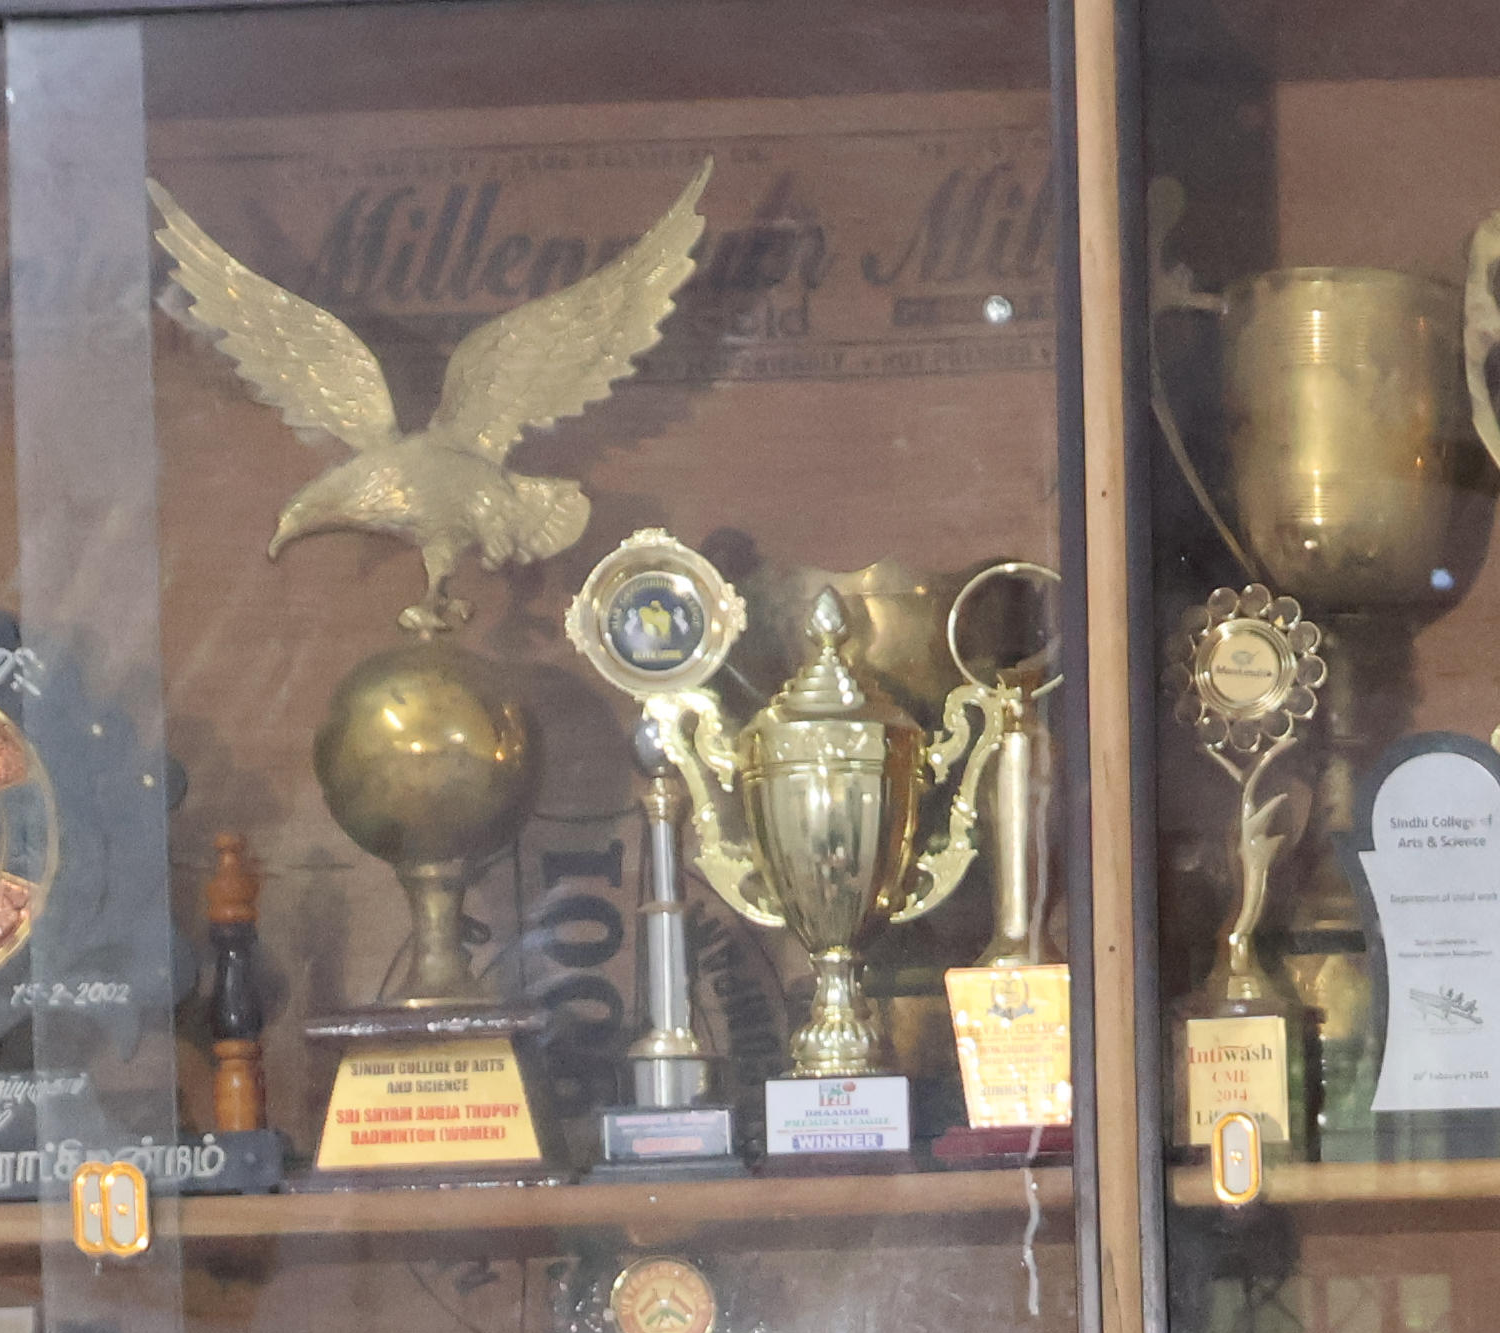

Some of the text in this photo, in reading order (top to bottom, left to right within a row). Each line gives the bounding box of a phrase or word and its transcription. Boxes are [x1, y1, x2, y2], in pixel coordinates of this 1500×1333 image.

[1390, 815, 1428, 829] Sindhi
[1398, 836, 1487, 849] Arts & Science
[351, 1058, 505, 1076] SINDHI COLLEGE OF ARTS
[387, 1079, 469, 1094] AND SCIENCE
[466, 1104, 520, 1119] TROPHY
[351, 1127, 436, 1145] BADMINTON
[798, 1132, 879, 1150] WINNER
